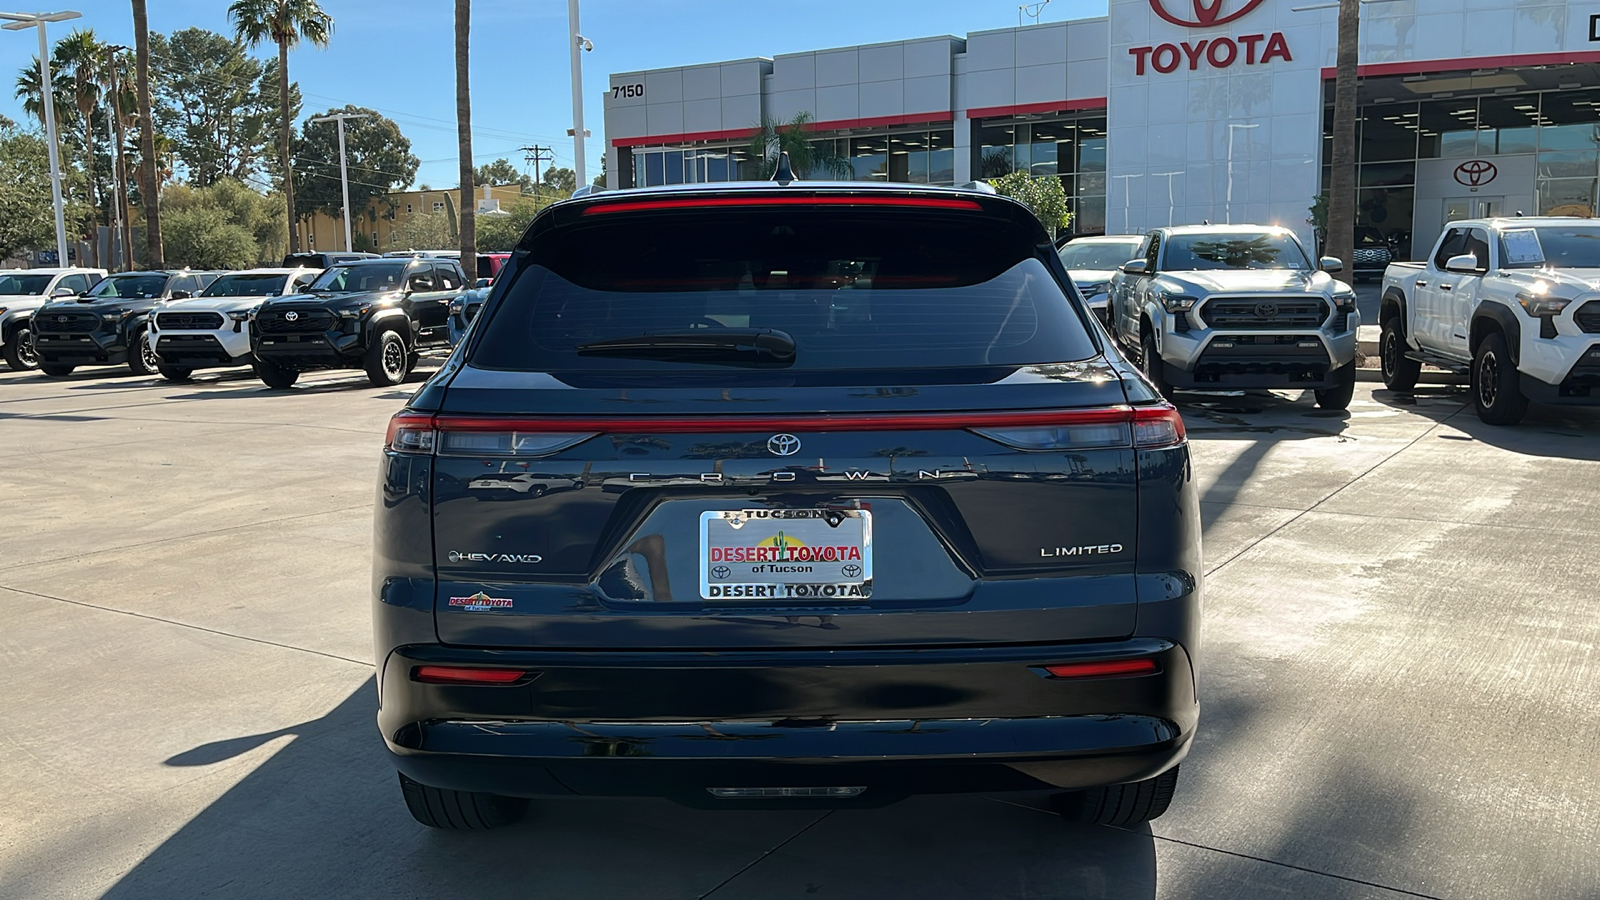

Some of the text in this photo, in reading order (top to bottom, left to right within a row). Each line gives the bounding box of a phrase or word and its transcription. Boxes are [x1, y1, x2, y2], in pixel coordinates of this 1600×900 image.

[1128, 32, 1293, 76] TOYOTA
[612, 84, 644, 99] 7150
[629, 469, 941, 482] CROWN
[743, 510, 822, 519] TUCSON
[711, 546, 861, 562] DESERT TOYOTA
[1040, 543, 1123, 557] LIMITED
[751, 564, 813, 574] of Tucson
[709, 585, 862, 597] DESERT TOYOTA
